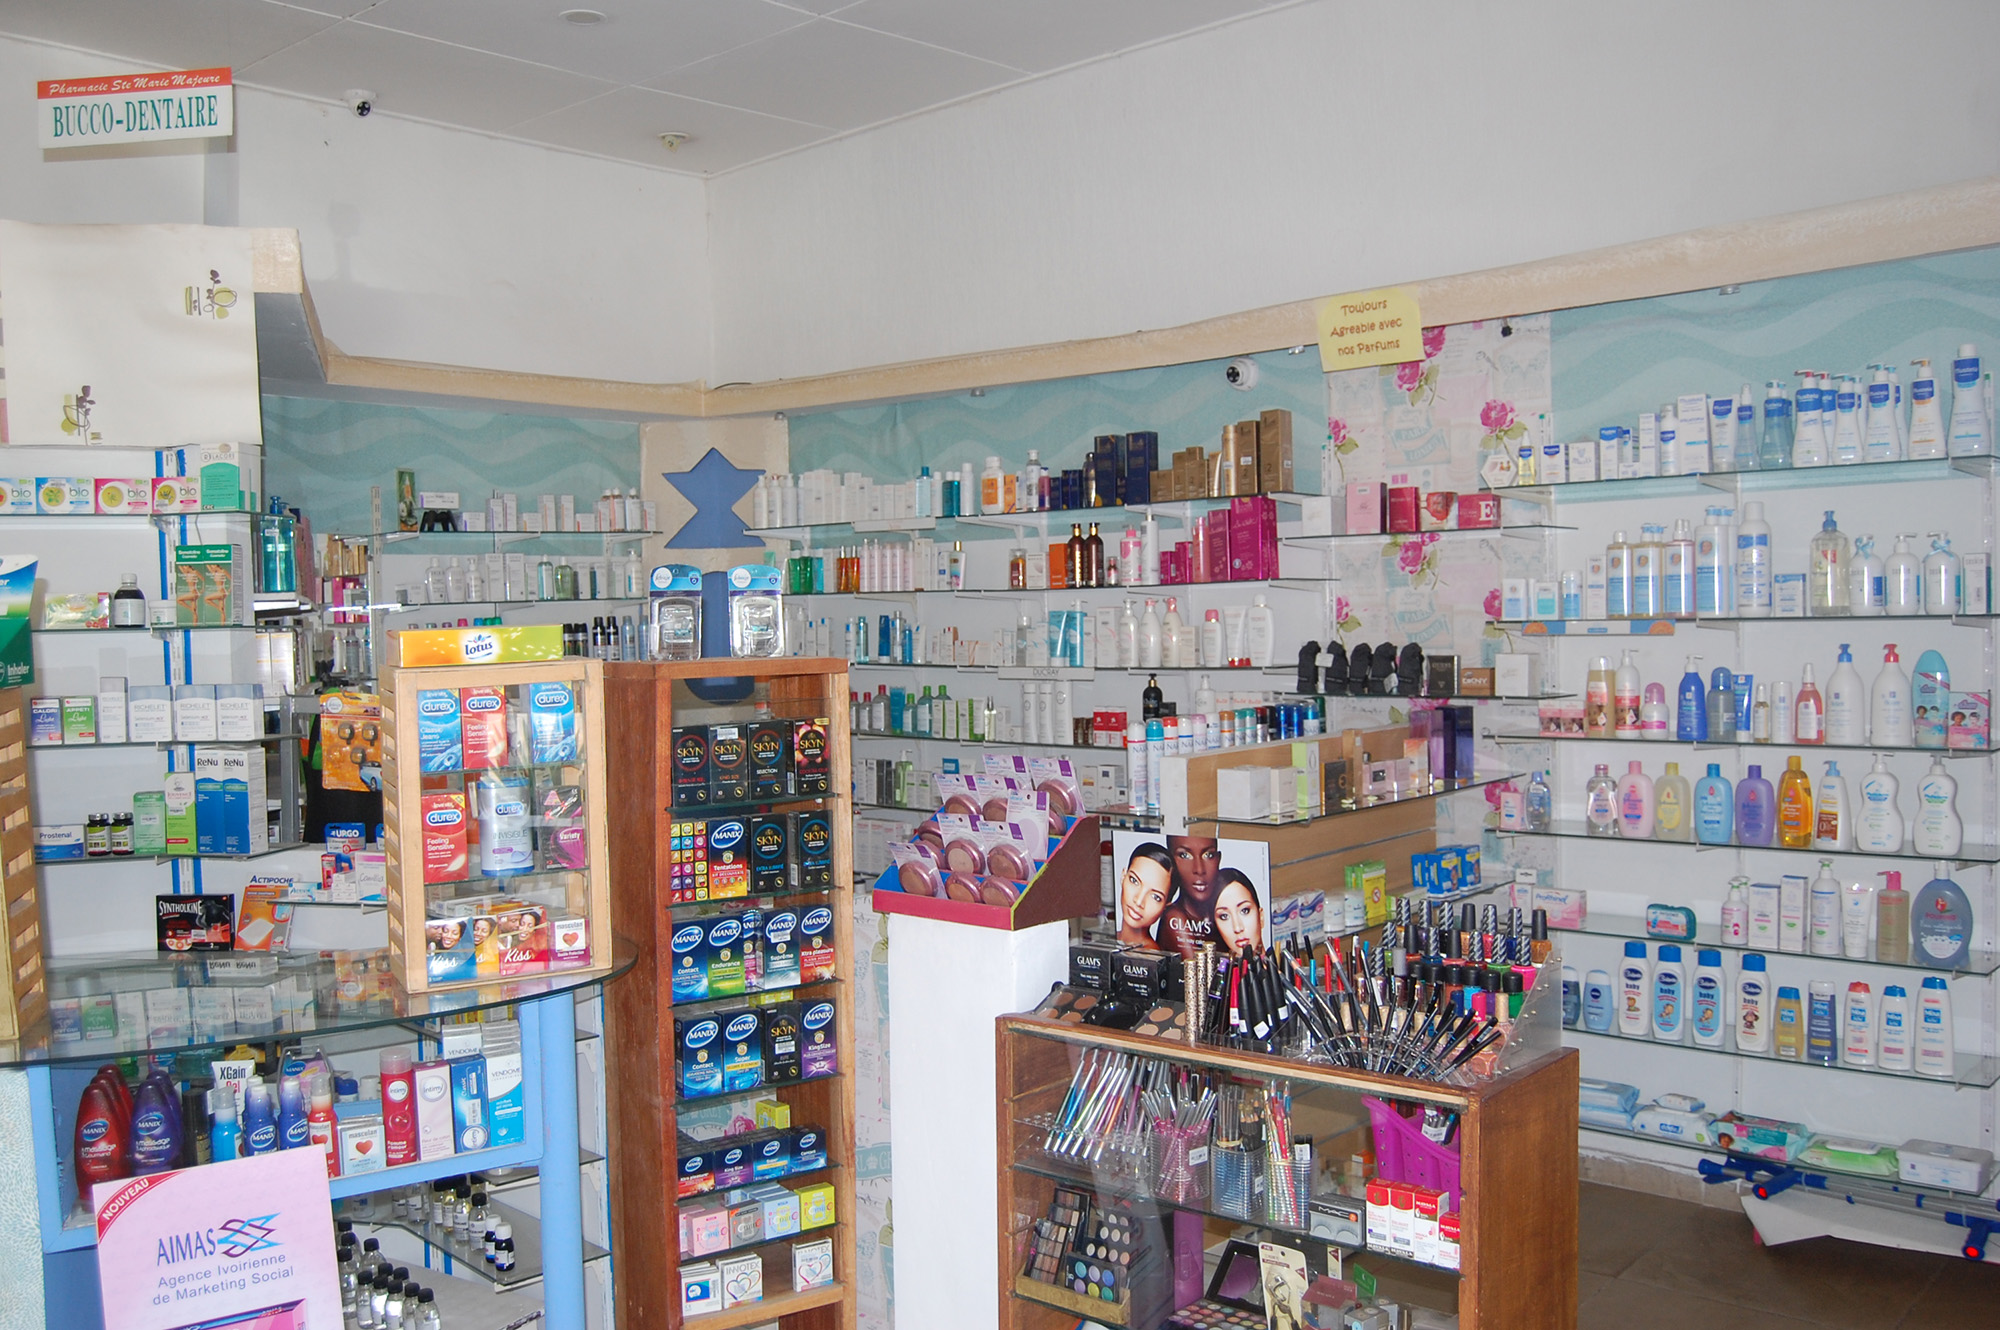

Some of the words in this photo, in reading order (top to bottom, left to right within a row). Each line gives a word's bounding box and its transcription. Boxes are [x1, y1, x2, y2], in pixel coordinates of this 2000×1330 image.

[49, 82, 108, 96] Pharmacie
[111, 79, 131, 91] Ste
[133, 77, 170, 89] Marie
[171, 74, 221, 87] Majeure
[53, 95, 219, 137] BUCCO-DENTAIRE
[1341, 300, 1388, 316] Toujours
[1330, 322, 1376, 337] Agreable
[1379, 318, 1403, 330] avec
[1337, 345, 1355, 356] nos
[1357, 340, 1400, 354] Parfums
[11, 487, 31, 498] bio
[69, 487, 89, 498] bio
[127, 488, 147, 499] bio
[180, 487, 197, 496] bio
[464, 642, 493, 656] lotus
[7, 662, 30, 676] Inhaler
[468, 699, 498, 708] durex
[536, 694, 565, 703] durex
[423, 702, 452, 711] durex
[753, 742, 779, 752] SKYN
[800, 739, 825, 749] SKYN
[677, 747, 704, 758] SKYN
[714, 745, 742, 755] SKYN
[197, 758, 218, 767] ReNu
[224, 758, 244, 767] ReNu
[496, 804, 525, 815] durex
[429, 813, 458, 822] durex
[39, 831, 72, 840] Prostenal
[334, 829, 359, 838] URGO
[715, 830, 742, 840] MANIX
[803, 831, 829, 841] SKYN
[427, 838, 449, 846] Feeling
[756, 835, 782, 846] SKYN
[427, 843, 455, 851] Sensitive
[158, 899, 202, 917] SYNTHOLKINE
[769, 920, 795, 930] MANIX
[804, 916, 830, 926] MANIX
[1169, 917, 1211, 934] GLAM'S
[711, 927, 739, 938] MANIX
[674, 934, 701, 944] MANIX
[504, 947, 531, 962] Kiss
[711, 960, 740, 969] Endurance
[1077, 955, 1101, 967] GLAM'S
[677, 967, 699, 975] Contact
[1123, 964, 1148, 977] GLAM'S
[807, 1011, 833, 1021] MANIX
[729, 1022, 756, 1033] MANIX
[770, 1025, 796, 1036] SKYN
[688, 1029, 716, 1039] MANIX
[735, 1055, 750, 1063] Super
[220, 1067, 246, 1080] XGain
[492, 1067, 521, 1077] VENDOME
[348, 1129, 377, 1139] masculan
[102, 1178, 150, 1220] NOUVEAU
[157, 1228, 216, 1266] AIMAS
[158, 1270, 212, 1289] Agence
[218, 1254, 286, 1276] Ivoirienne
[153, 1292, 170, 1305] de
[177, 1278, 246, 1301] Marketing
[252, 1266, 294, 1284] Social
